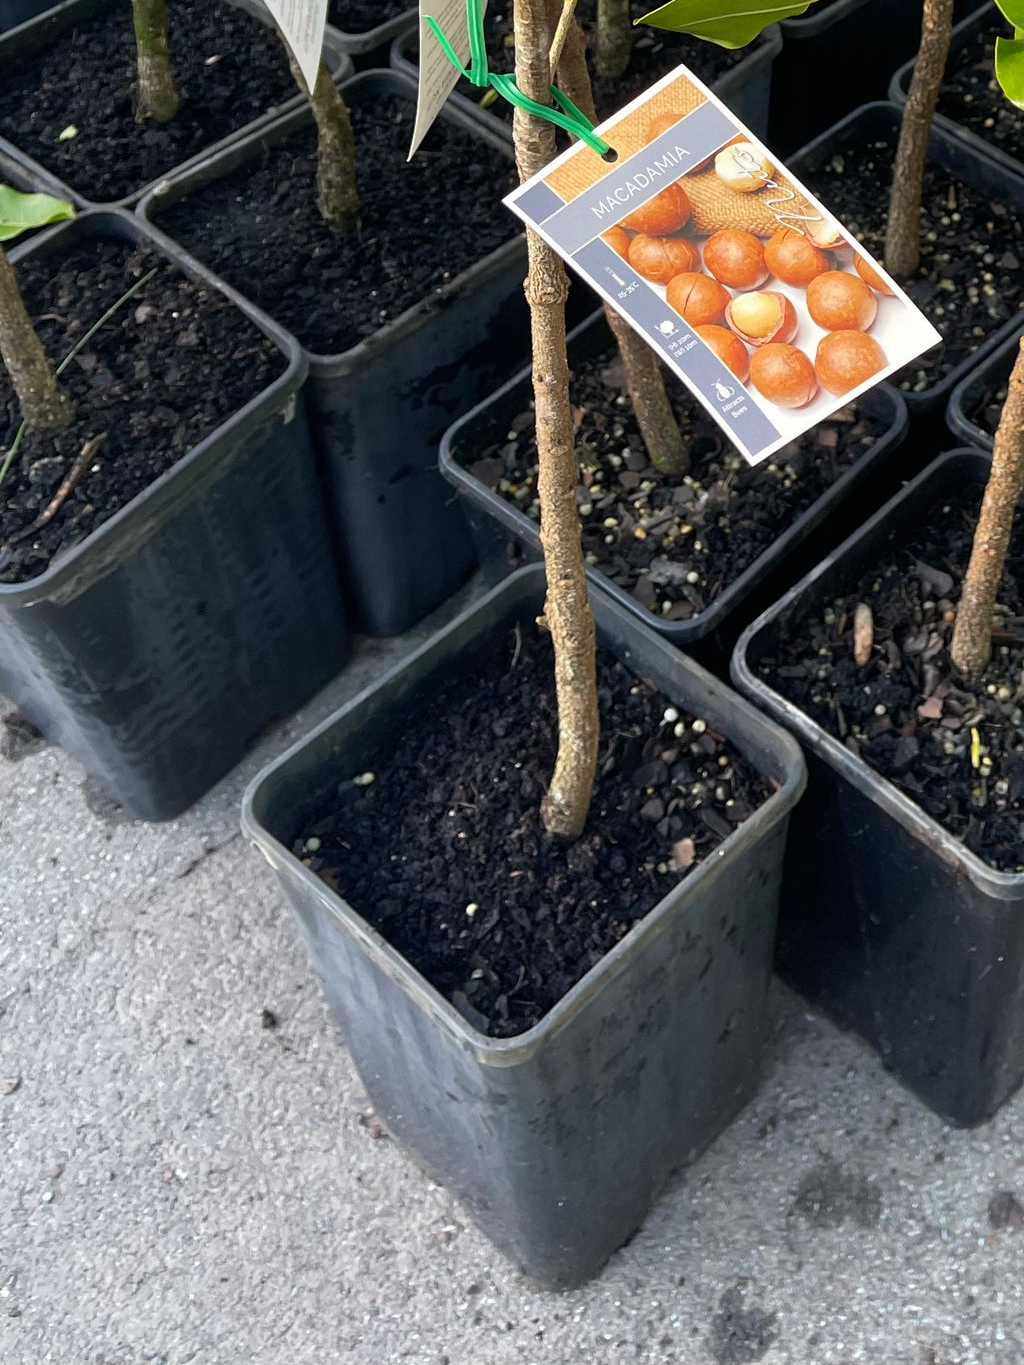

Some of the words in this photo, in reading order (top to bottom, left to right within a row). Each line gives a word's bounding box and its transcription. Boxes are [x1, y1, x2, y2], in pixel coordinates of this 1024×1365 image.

[590, 145, 691, 219] MACADAMIA
[721, 394, 745, 413] Attracts
[731, 406, 748, 419] Bees
